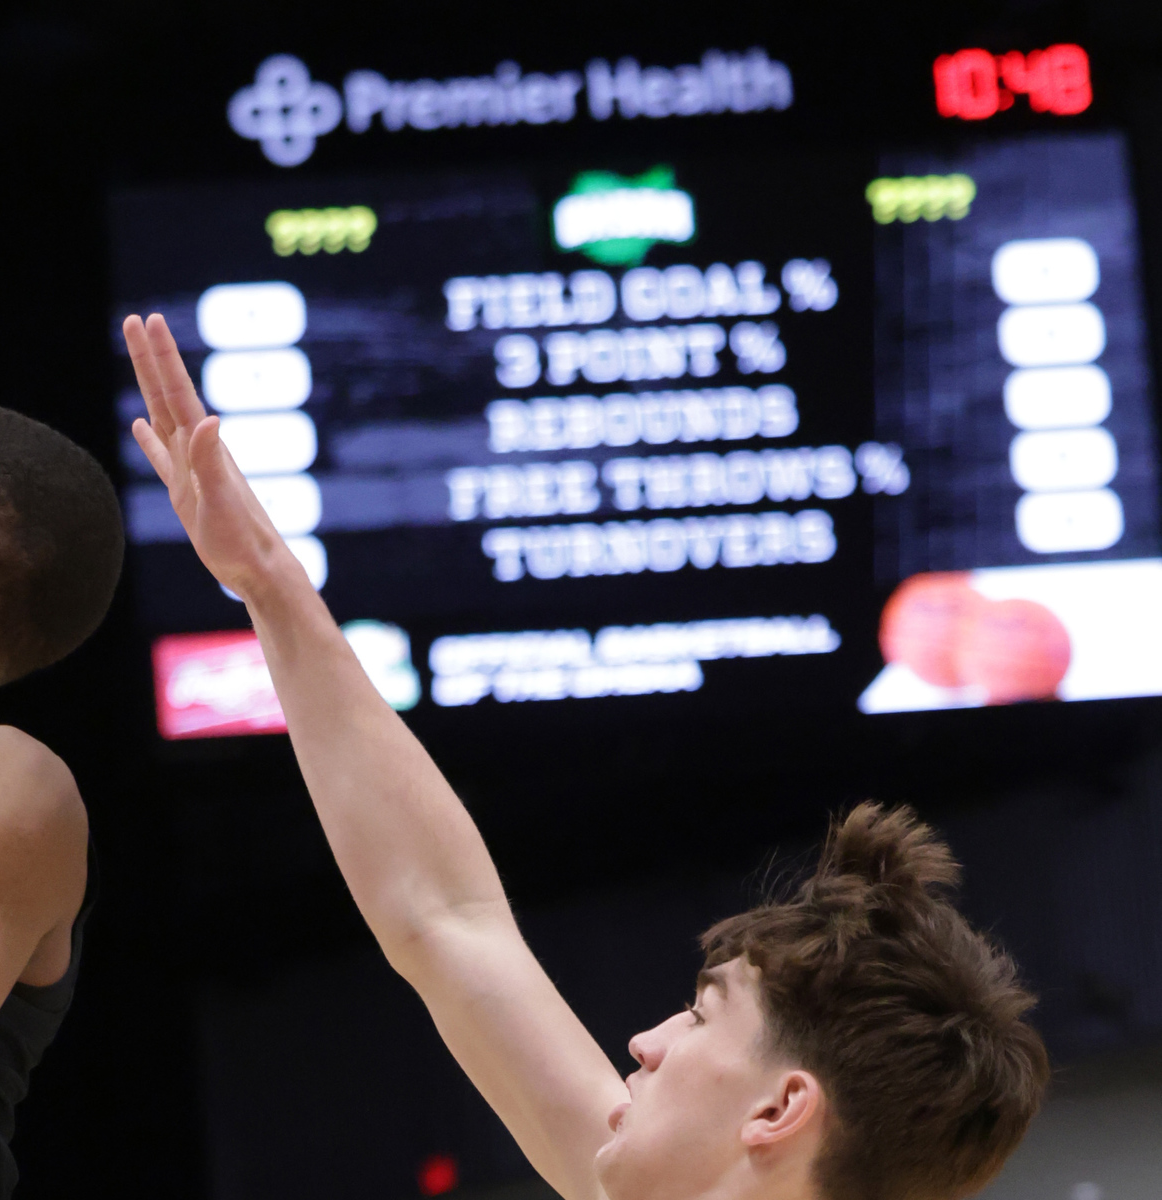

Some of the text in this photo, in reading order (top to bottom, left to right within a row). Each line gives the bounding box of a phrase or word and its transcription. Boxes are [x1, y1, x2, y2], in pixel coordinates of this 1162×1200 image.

[344, 47, 794, 134] Premier Health
[444, 258, 838, 331] FIELD GOAL %
[494, 320, 787, 389] 3 POINT %
[485, 384, 799, 453] REBOUNDS
[446, 460, 601, 521] FREE
[482, 509, 836, 582] TURNOVERS
